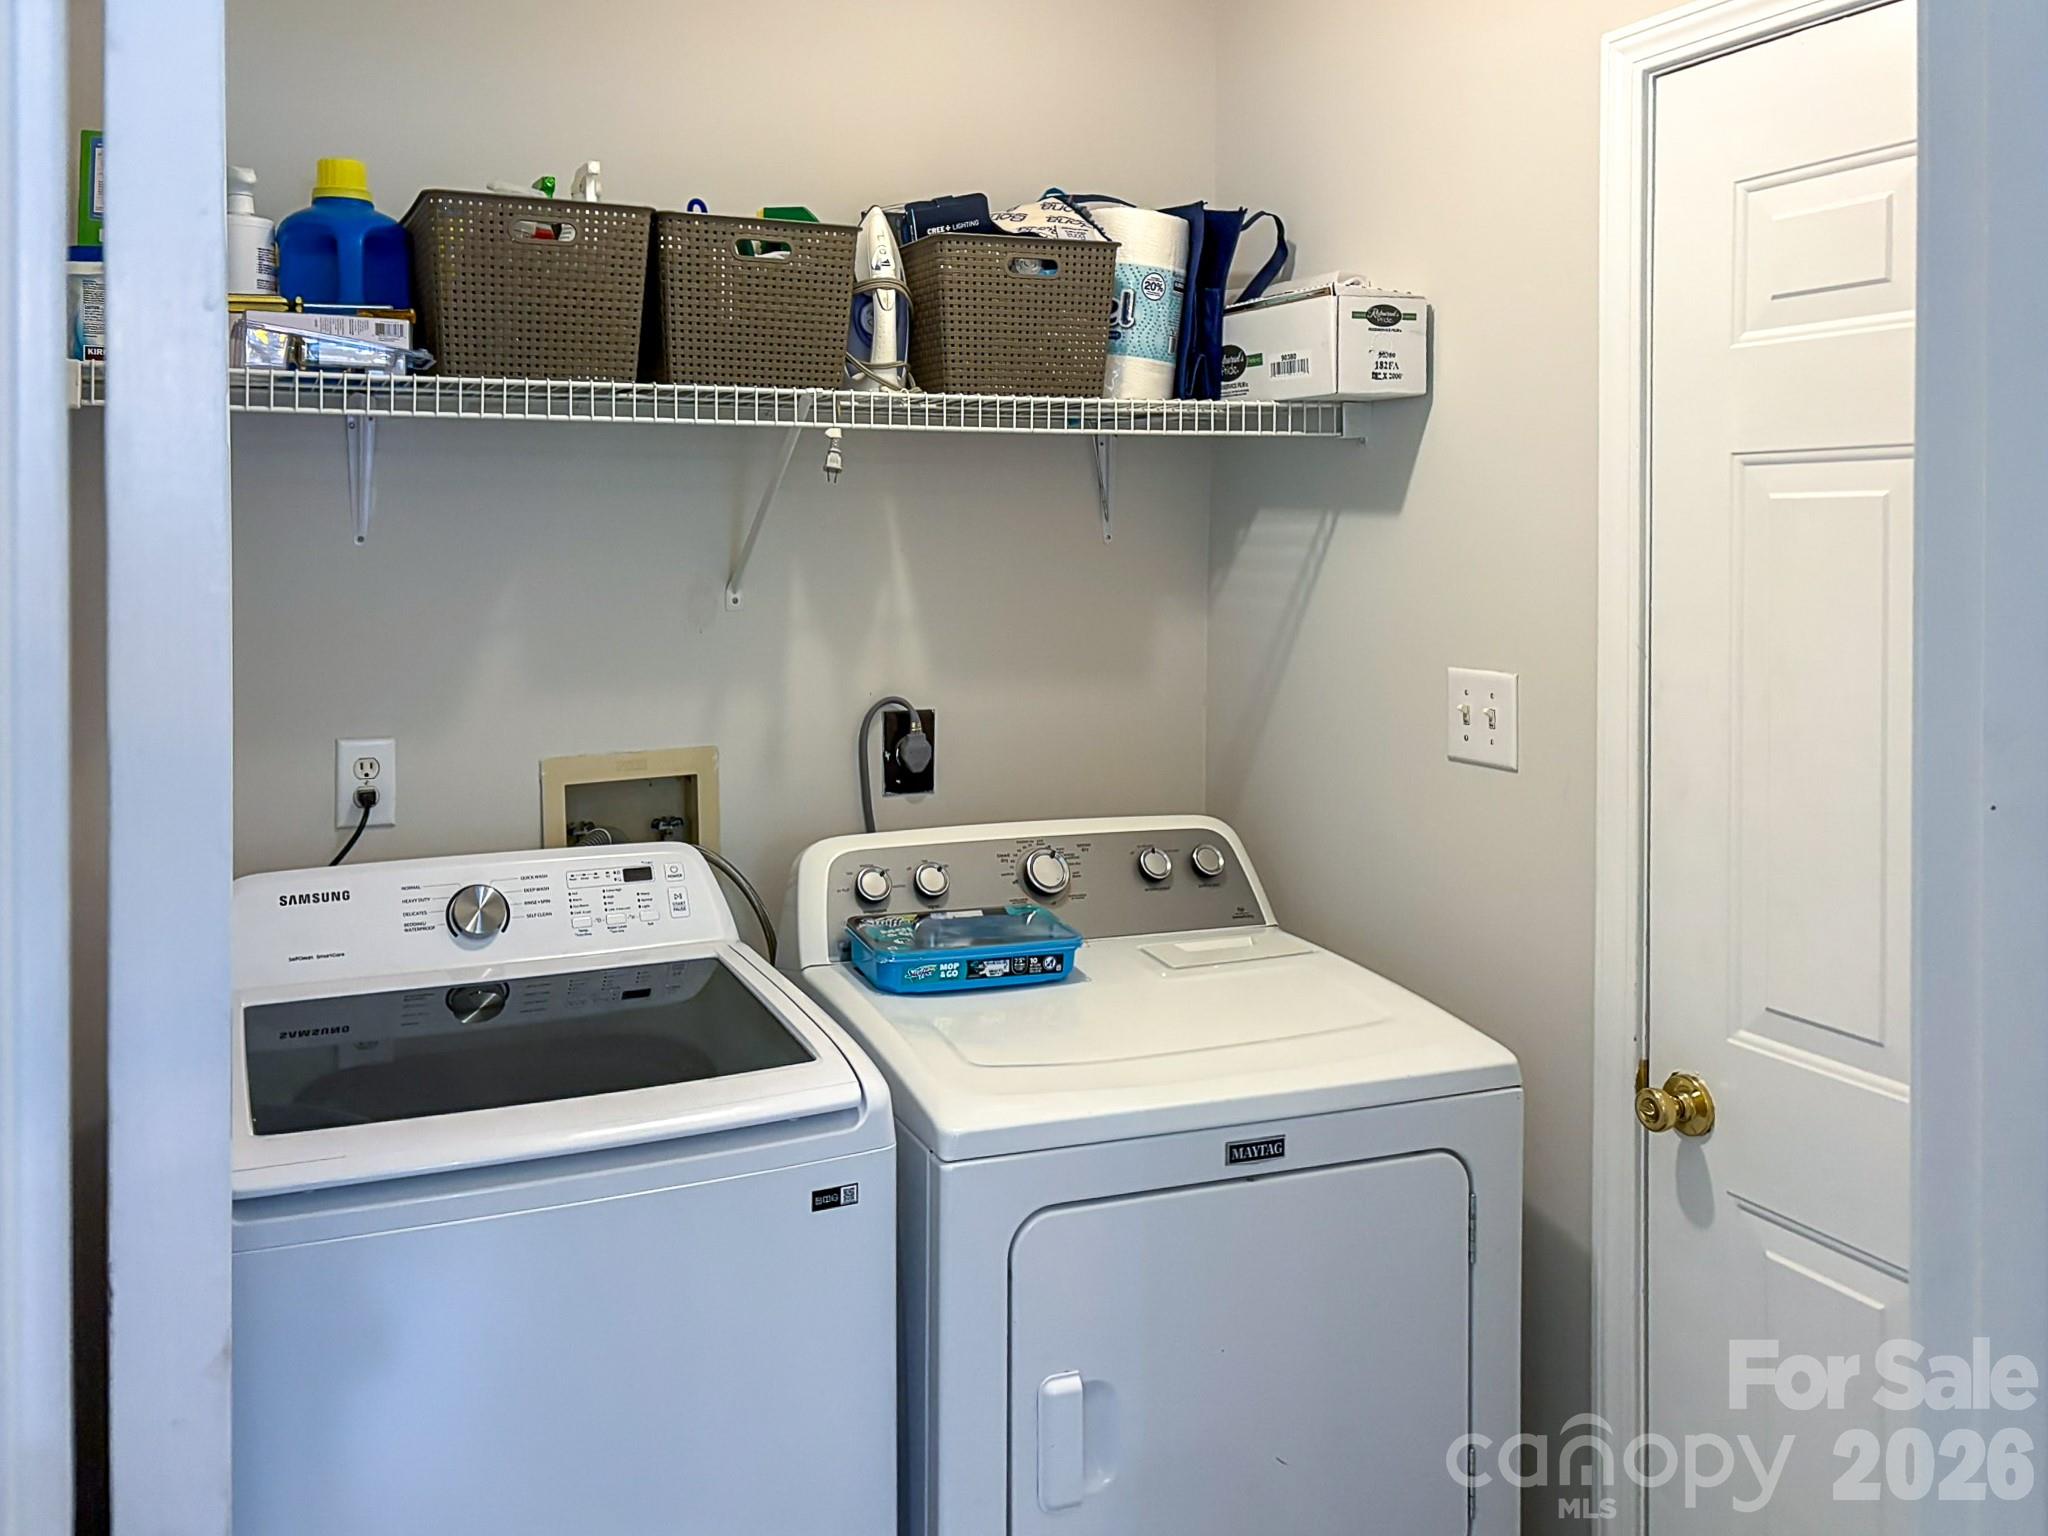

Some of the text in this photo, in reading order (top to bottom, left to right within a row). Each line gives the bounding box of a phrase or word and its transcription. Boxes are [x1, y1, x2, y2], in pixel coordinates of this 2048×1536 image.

[952, 219, 979, 230] LIGHTING
[1144, 280, 1164, 292] 20%
[87, 348, 105, 356] KIR
[279, 890, 350, 906] SAMSUNG
[940, 962, 960, 970] MOP
[1231, 1142, 1283, 1160] MAYTAG
